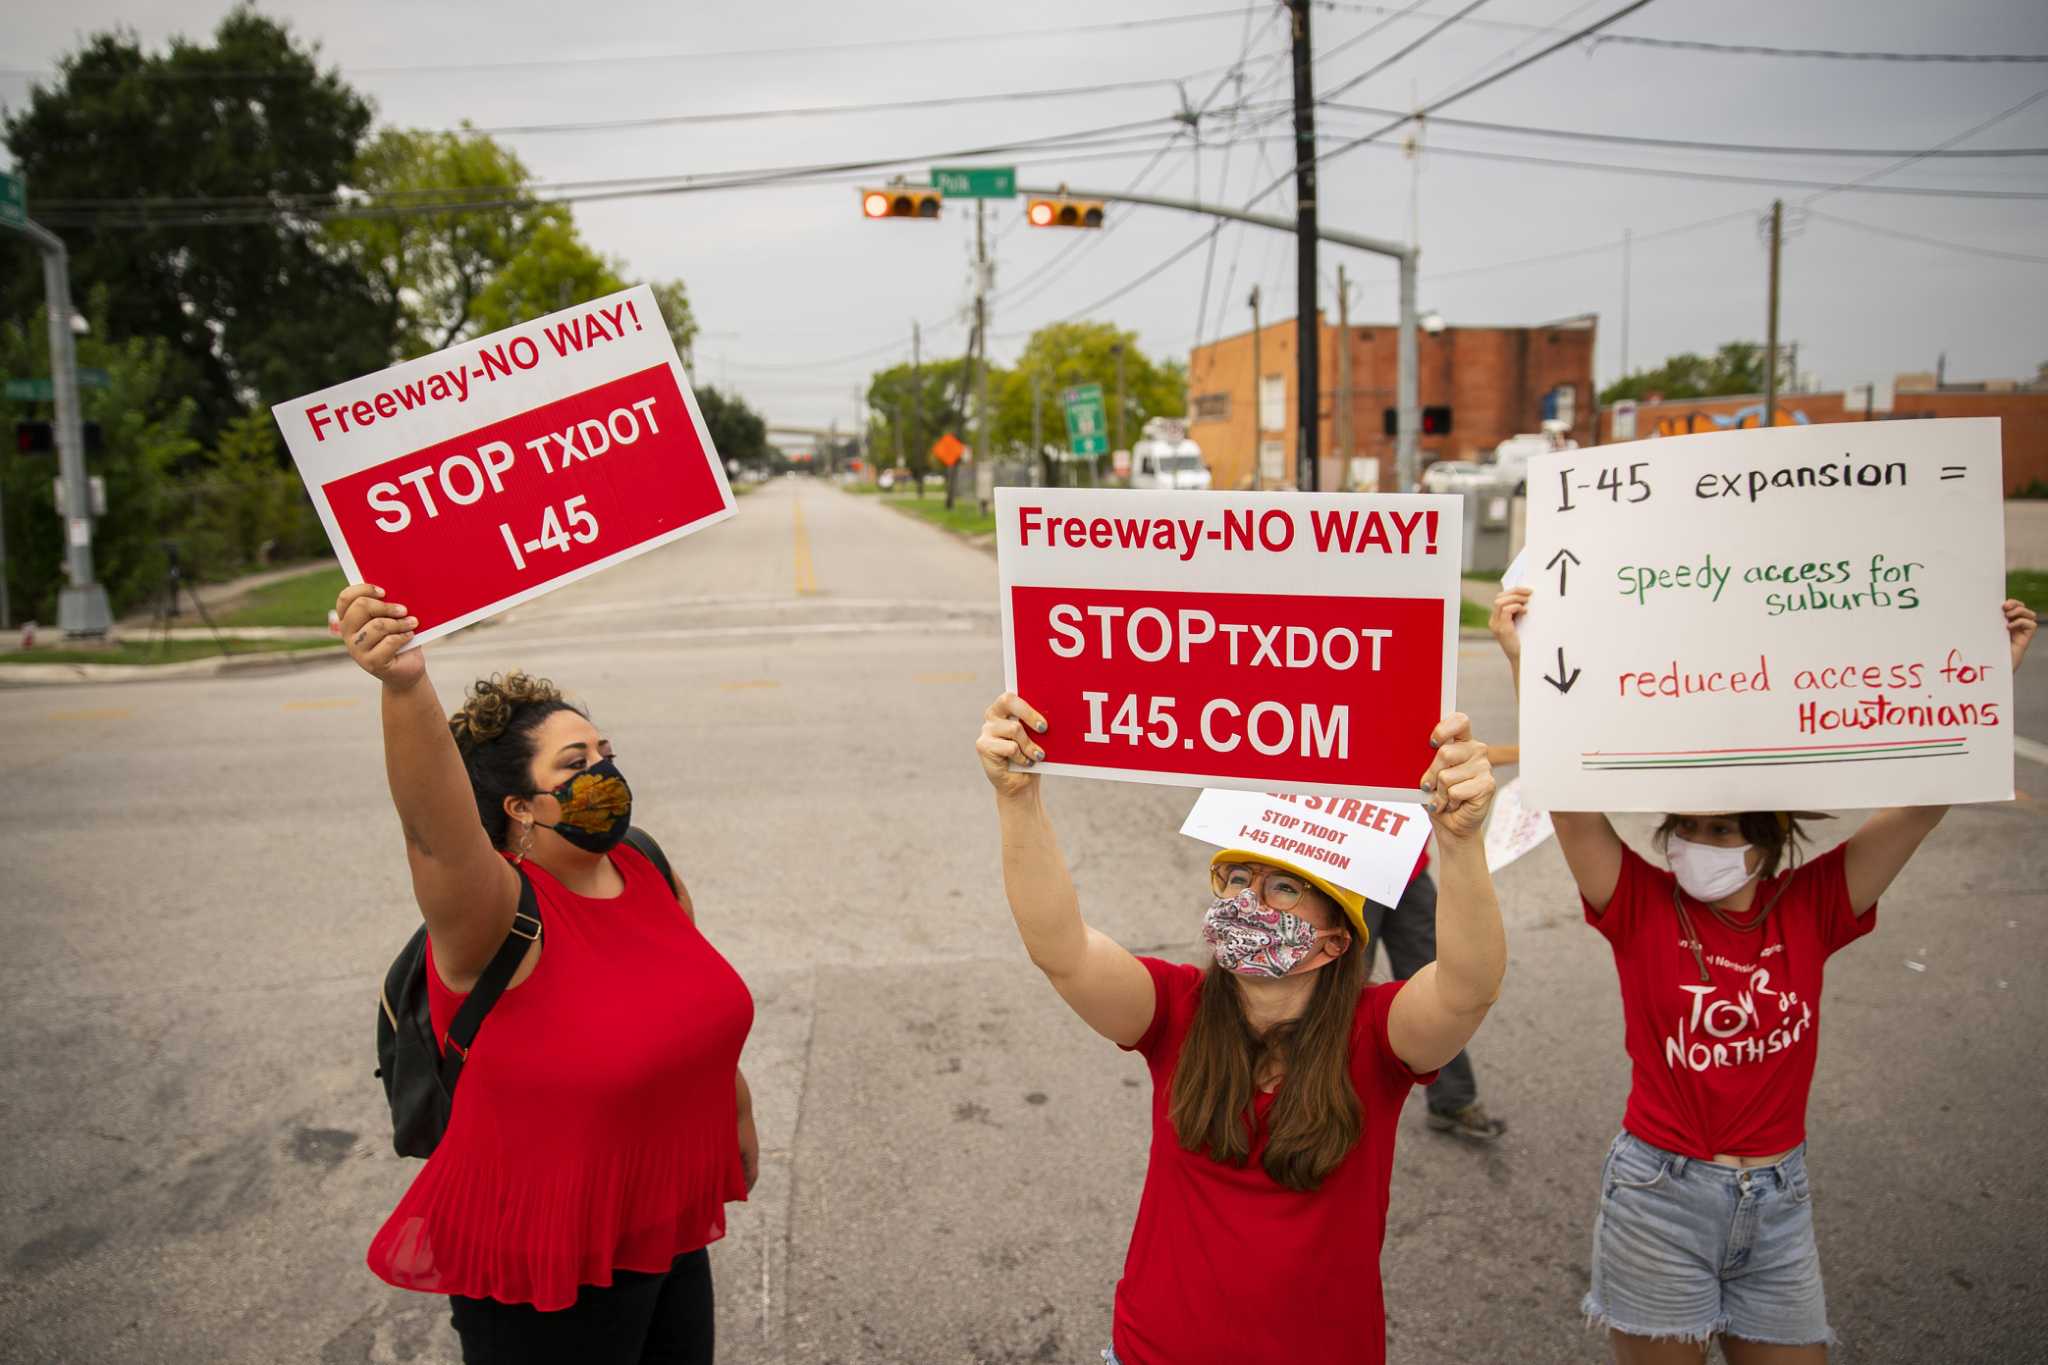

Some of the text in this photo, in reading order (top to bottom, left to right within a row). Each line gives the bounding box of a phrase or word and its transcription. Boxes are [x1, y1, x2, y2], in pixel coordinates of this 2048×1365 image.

[305, 300, 643, 442] Freeway-NO WAY!
[367, 397, 661, 533] STOP TXDOT
[1556, 462, 1652, 512] I-45
[1695, 453, 1907, 502] expansion
[499, 495, 599, 570] I-45
[1019, 507, 1439, 561] Freeway-NO WAY!
[1616, 554, 1924, 604] speedy access for
[1766, 584, 1920, 616] suburbs
[1619, 649, 1994, 698] reduced access for
[1082, 691, 1350, 760] I45.COM
[1799, 694, 2000, 734] Houstonians
[1261, 809, 1349, 845] STOP TXDOT
[1305, 793, 1410, 838] STREET
[1238, 824, 1352, 870] I-45 EXPANSION
